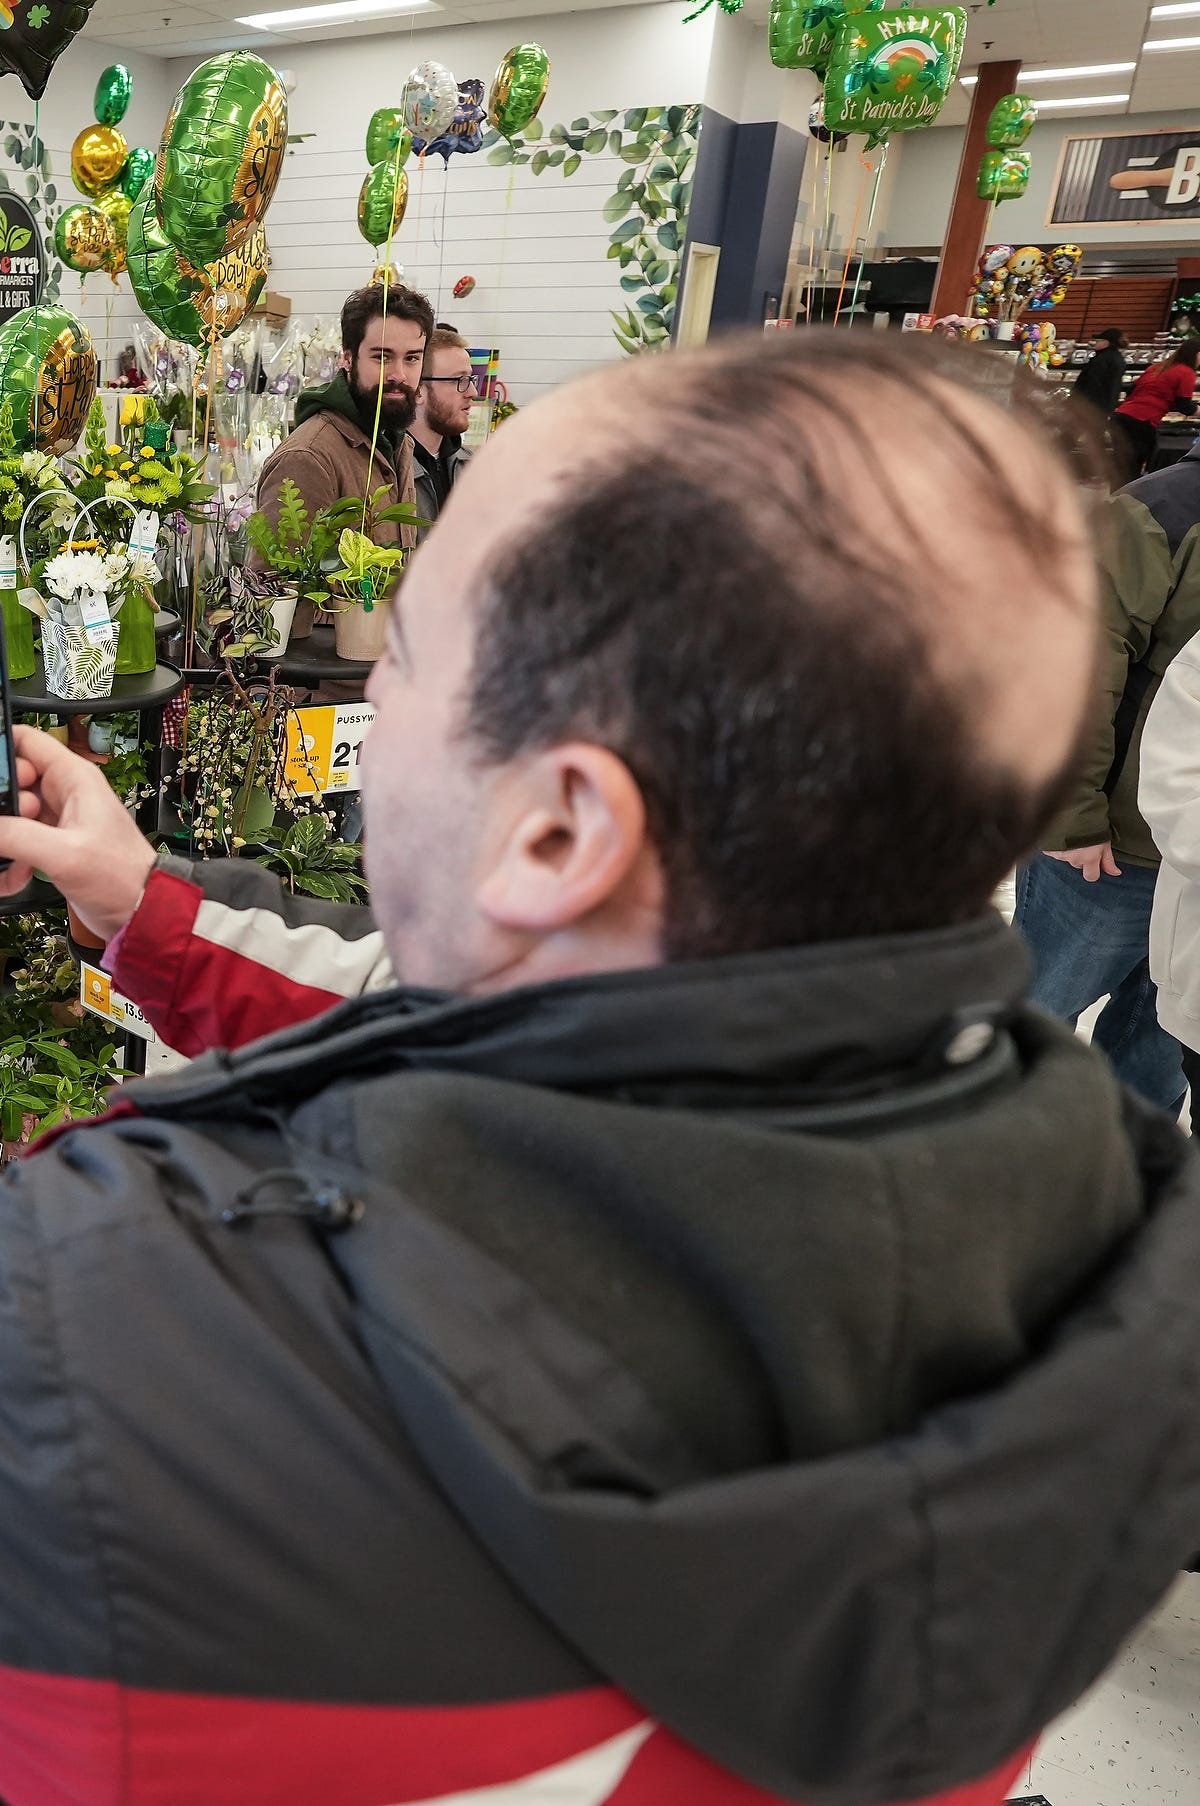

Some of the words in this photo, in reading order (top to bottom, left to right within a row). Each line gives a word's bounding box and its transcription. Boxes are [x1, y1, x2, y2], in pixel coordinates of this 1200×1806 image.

[877, 15, 942, 40] HAPPY
[840, 98, 857, 121] St
[861, 95, 915, 120] Patrick's
[5, 290, 12, 308] &
[12, 290, 30, 308] GIFTS
[337, 714, 376, 725] PUSSYW
[333, 741, 364, 767] 21
